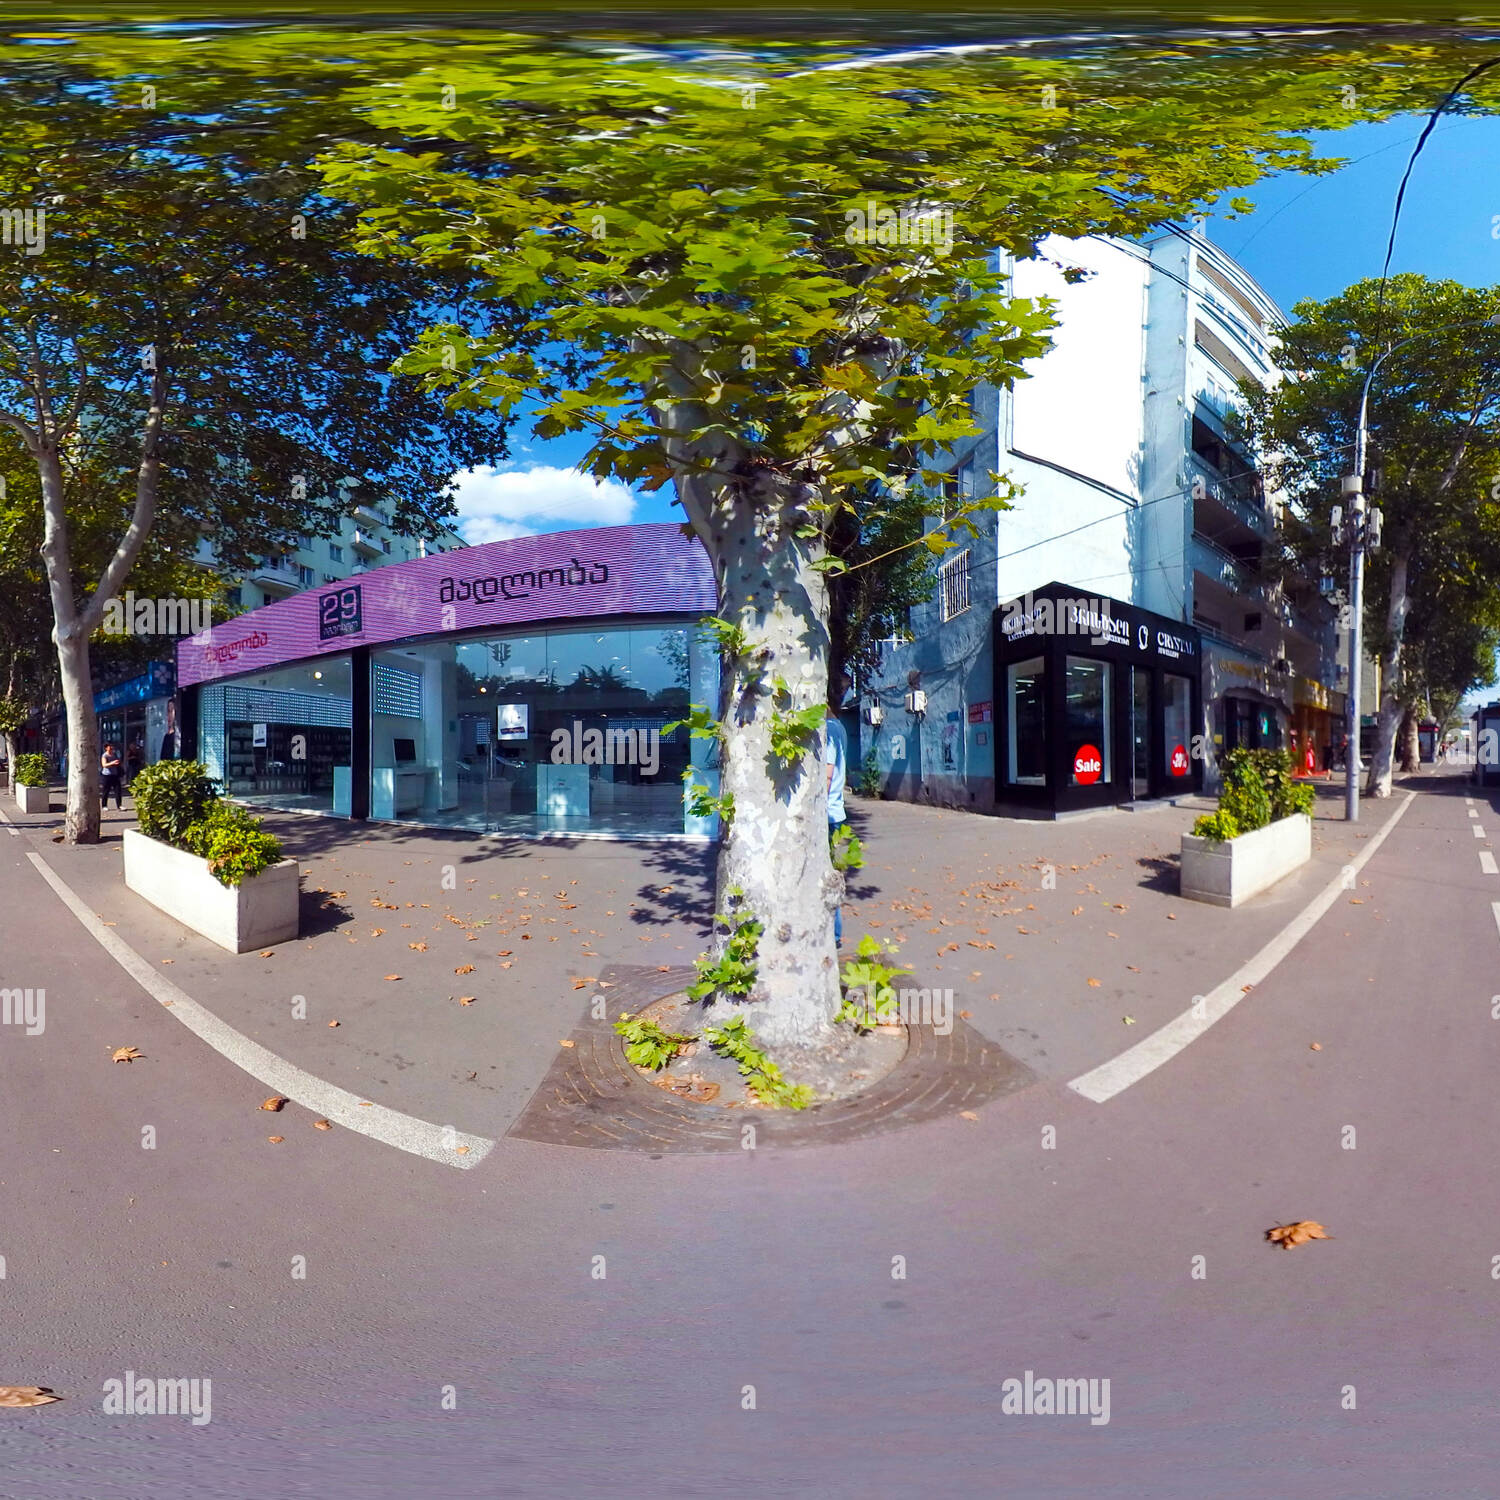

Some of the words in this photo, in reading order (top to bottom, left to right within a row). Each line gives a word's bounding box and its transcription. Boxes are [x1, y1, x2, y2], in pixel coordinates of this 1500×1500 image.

[440, 558, 609, 604] მადლობა
[323, 589, 357, 624] 29
[1157, 631, 1194, 656] CRYSTAL
[1075, 758, 1101, 772] Sale
